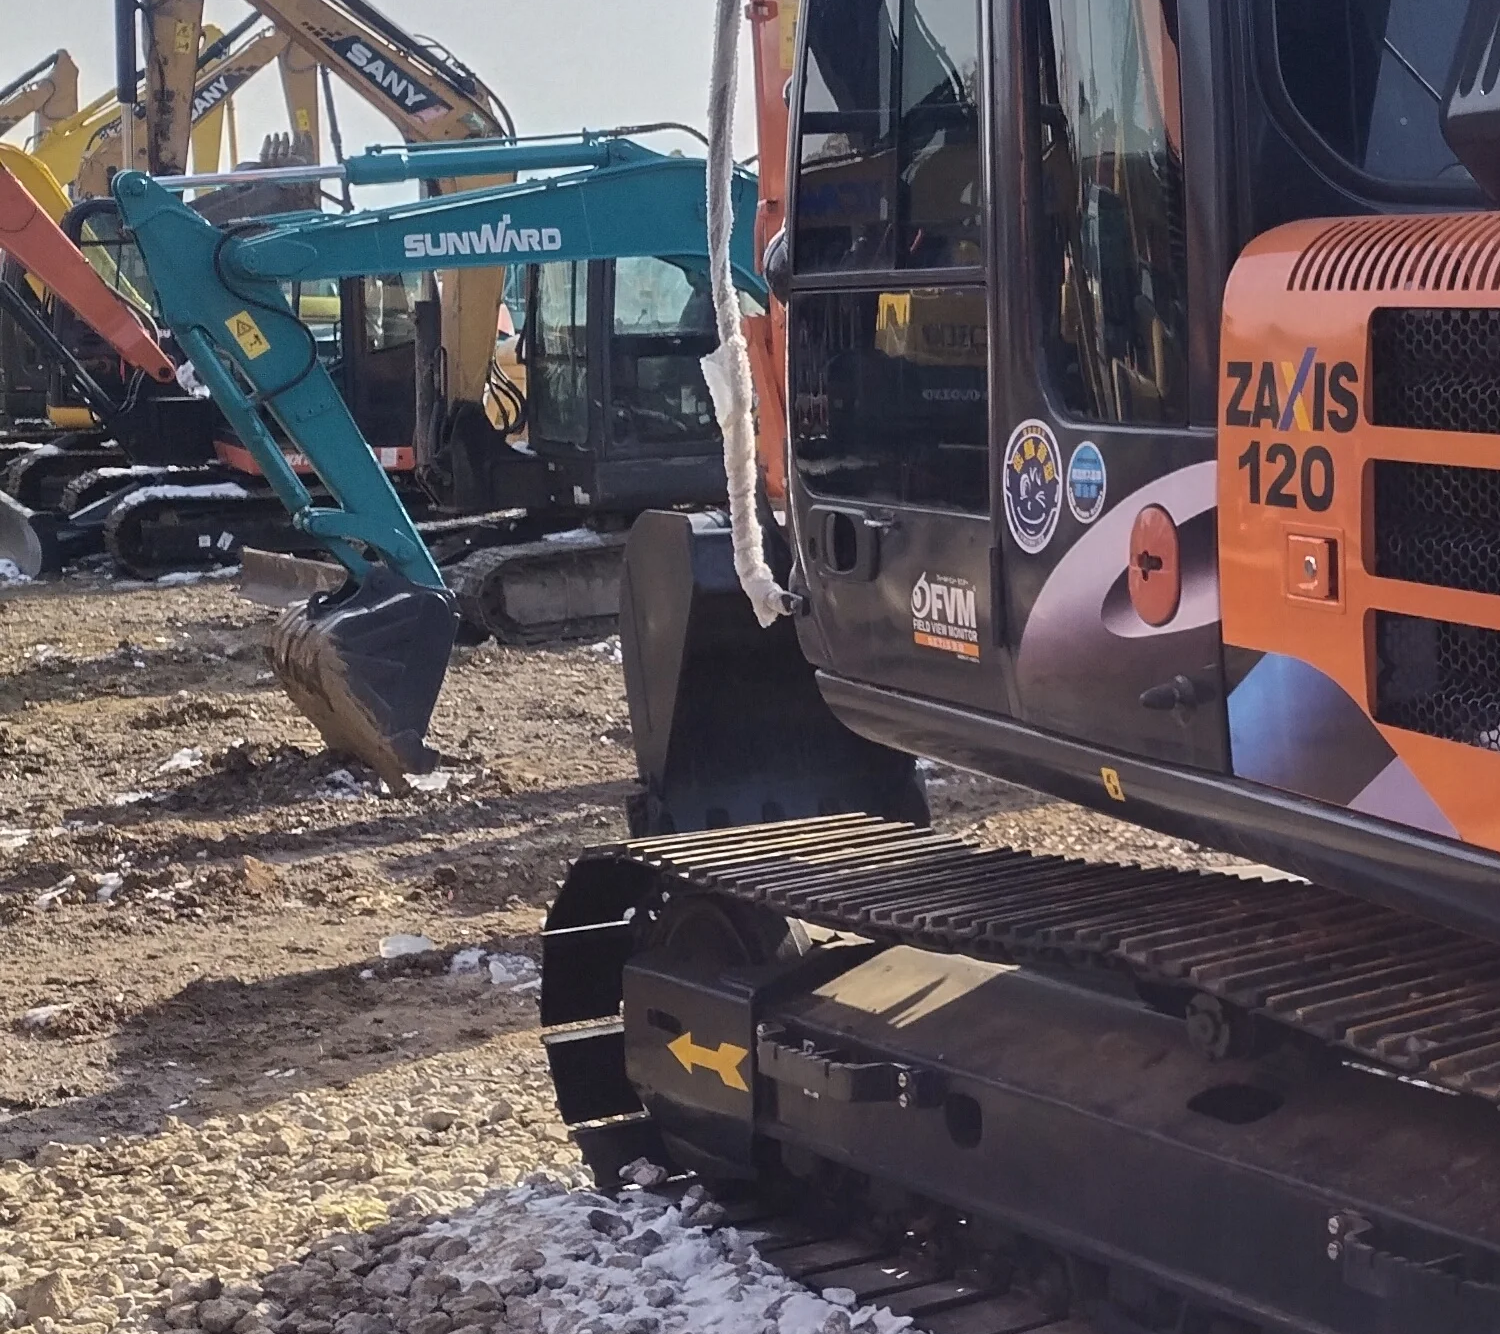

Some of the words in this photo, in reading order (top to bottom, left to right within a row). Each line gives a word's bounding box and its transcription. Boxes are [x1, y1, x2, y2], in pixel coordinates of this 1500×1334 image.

[346, 42, 427, 107] SANY
[404, 214, 562, 258] SUNWARD
[1226, 347, 1358, 433] ZAXIS
[1239, 441, 1335, 512] 120
[913, 618, 931, 632] FIELD
[931, 621, 948, 636] VIEW
[948, 626, 978, 642] MONITOR
[930, 583, 977, 629] FVM
